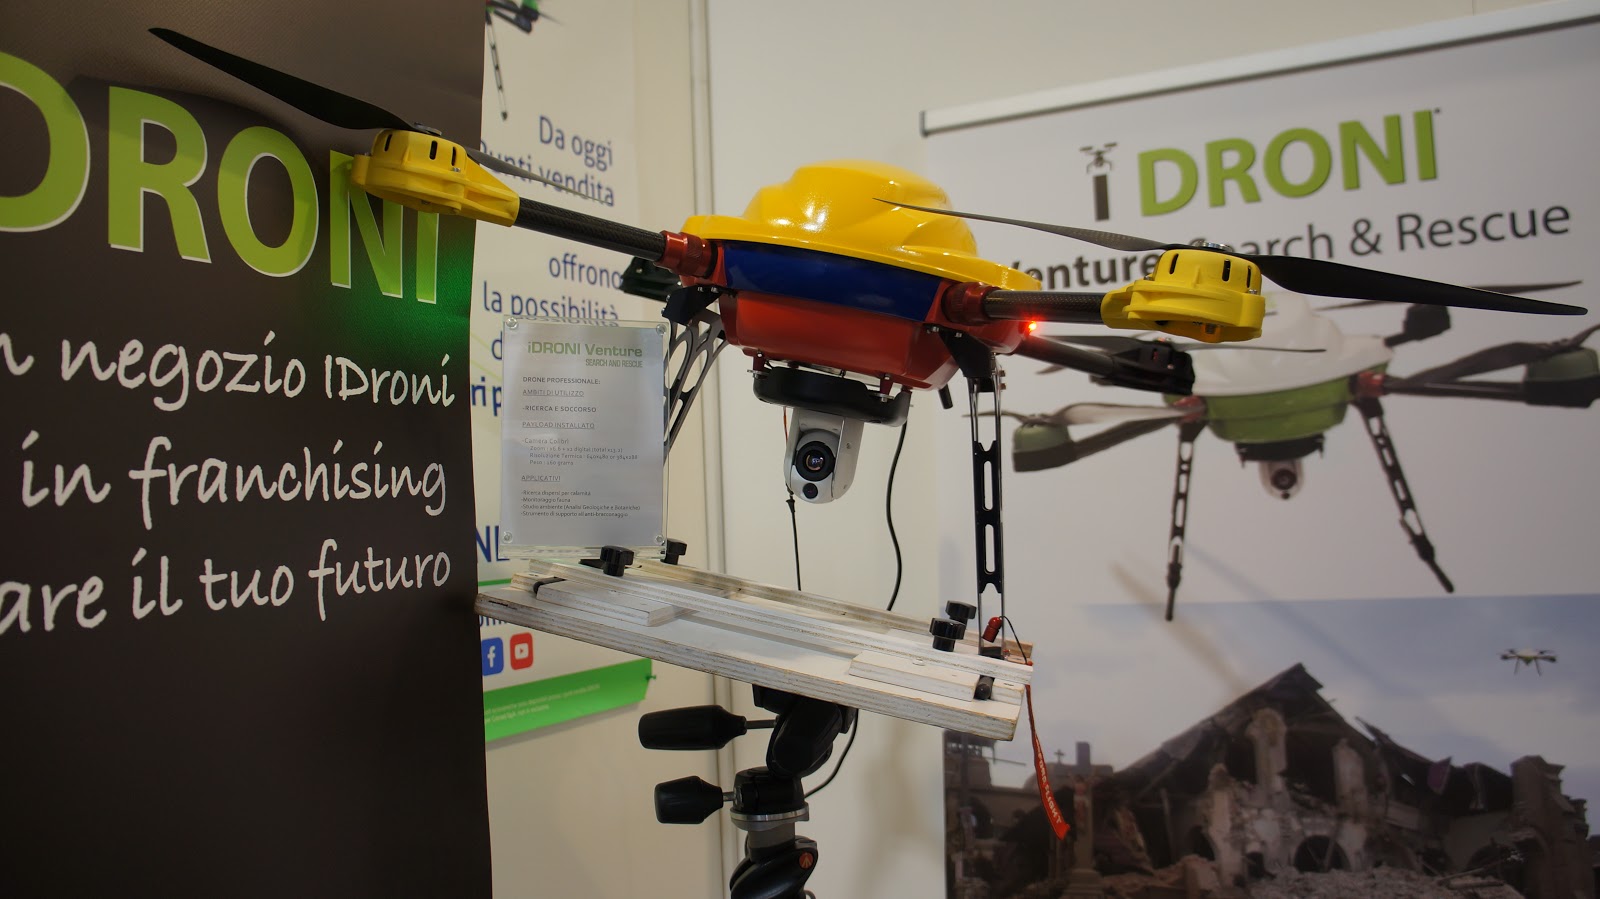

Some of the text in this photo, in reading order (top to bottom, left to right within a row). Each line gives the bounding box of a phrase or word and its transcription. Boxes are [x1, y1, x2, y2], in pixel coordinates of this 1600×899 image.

[538, 115, 613, 172] Da oggi
[1137, 110, 1438, 217] DRONI
[0, 51, 438, 305] DRONI
[1351, 216, 1381, 256] &
[1397, 205, 1570, 249] Rescue
[483, 281, 503, 315] la
[548, 252, 622, 290] offrono
[61, 331, 306, 412] negozio
[527, 341, 643, 358] iDRONI Venture
[585, 358, 643, 368] SEARCH AND RESCUE
[522, 421, 554, 429] PAYLOAD
[20, 431, 446, 530] in franchising
[130, 547, 182, 619] il
[199, 558, 294, 611] tuo
[308, 539, 451, 621] futuro
